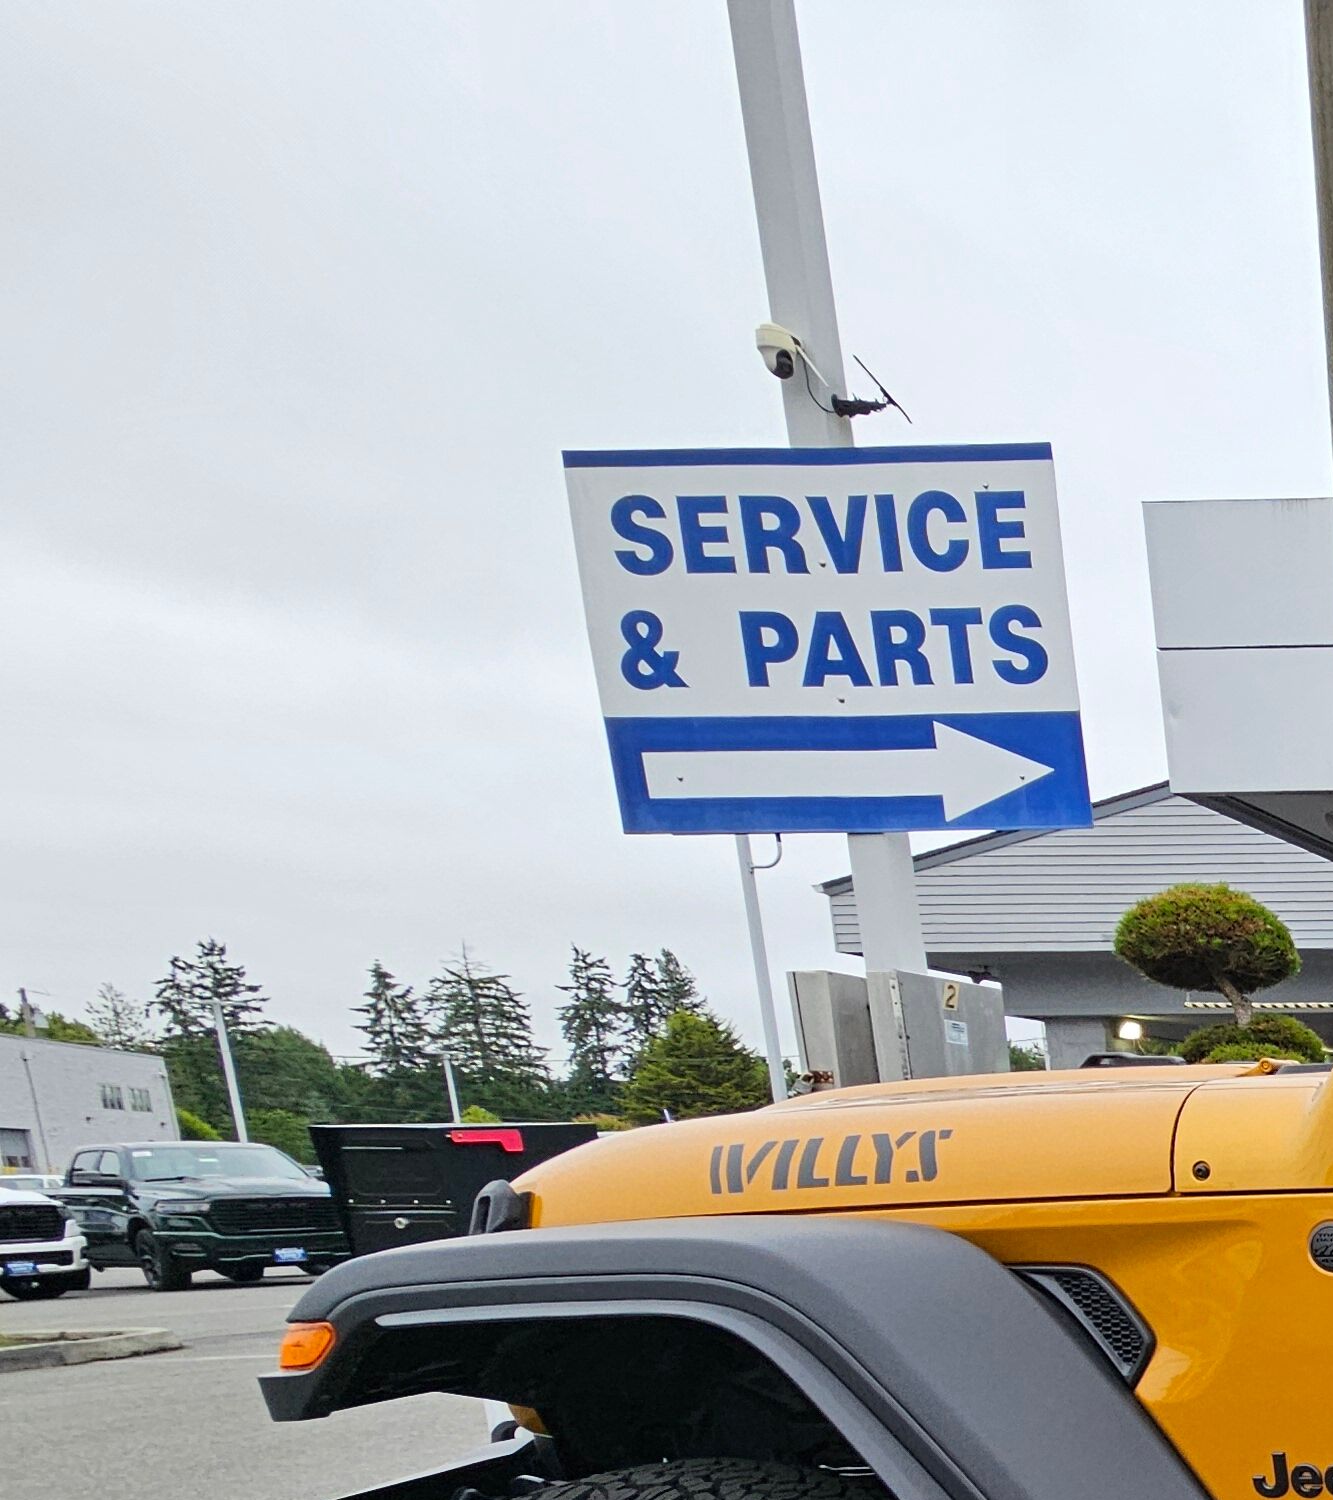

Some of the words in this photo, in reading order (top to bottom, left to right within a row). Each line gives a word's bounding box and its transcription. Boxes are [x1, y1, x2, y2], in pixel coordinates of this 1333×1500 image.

[610, 490, 1032, 576] SERVICE
[620, 609, 690, 691] &
[739, 604, 1049, 688] PARTS
[945, 984, 956, 1009] 2
[709, 1129, 954, 1195] WILLYS
